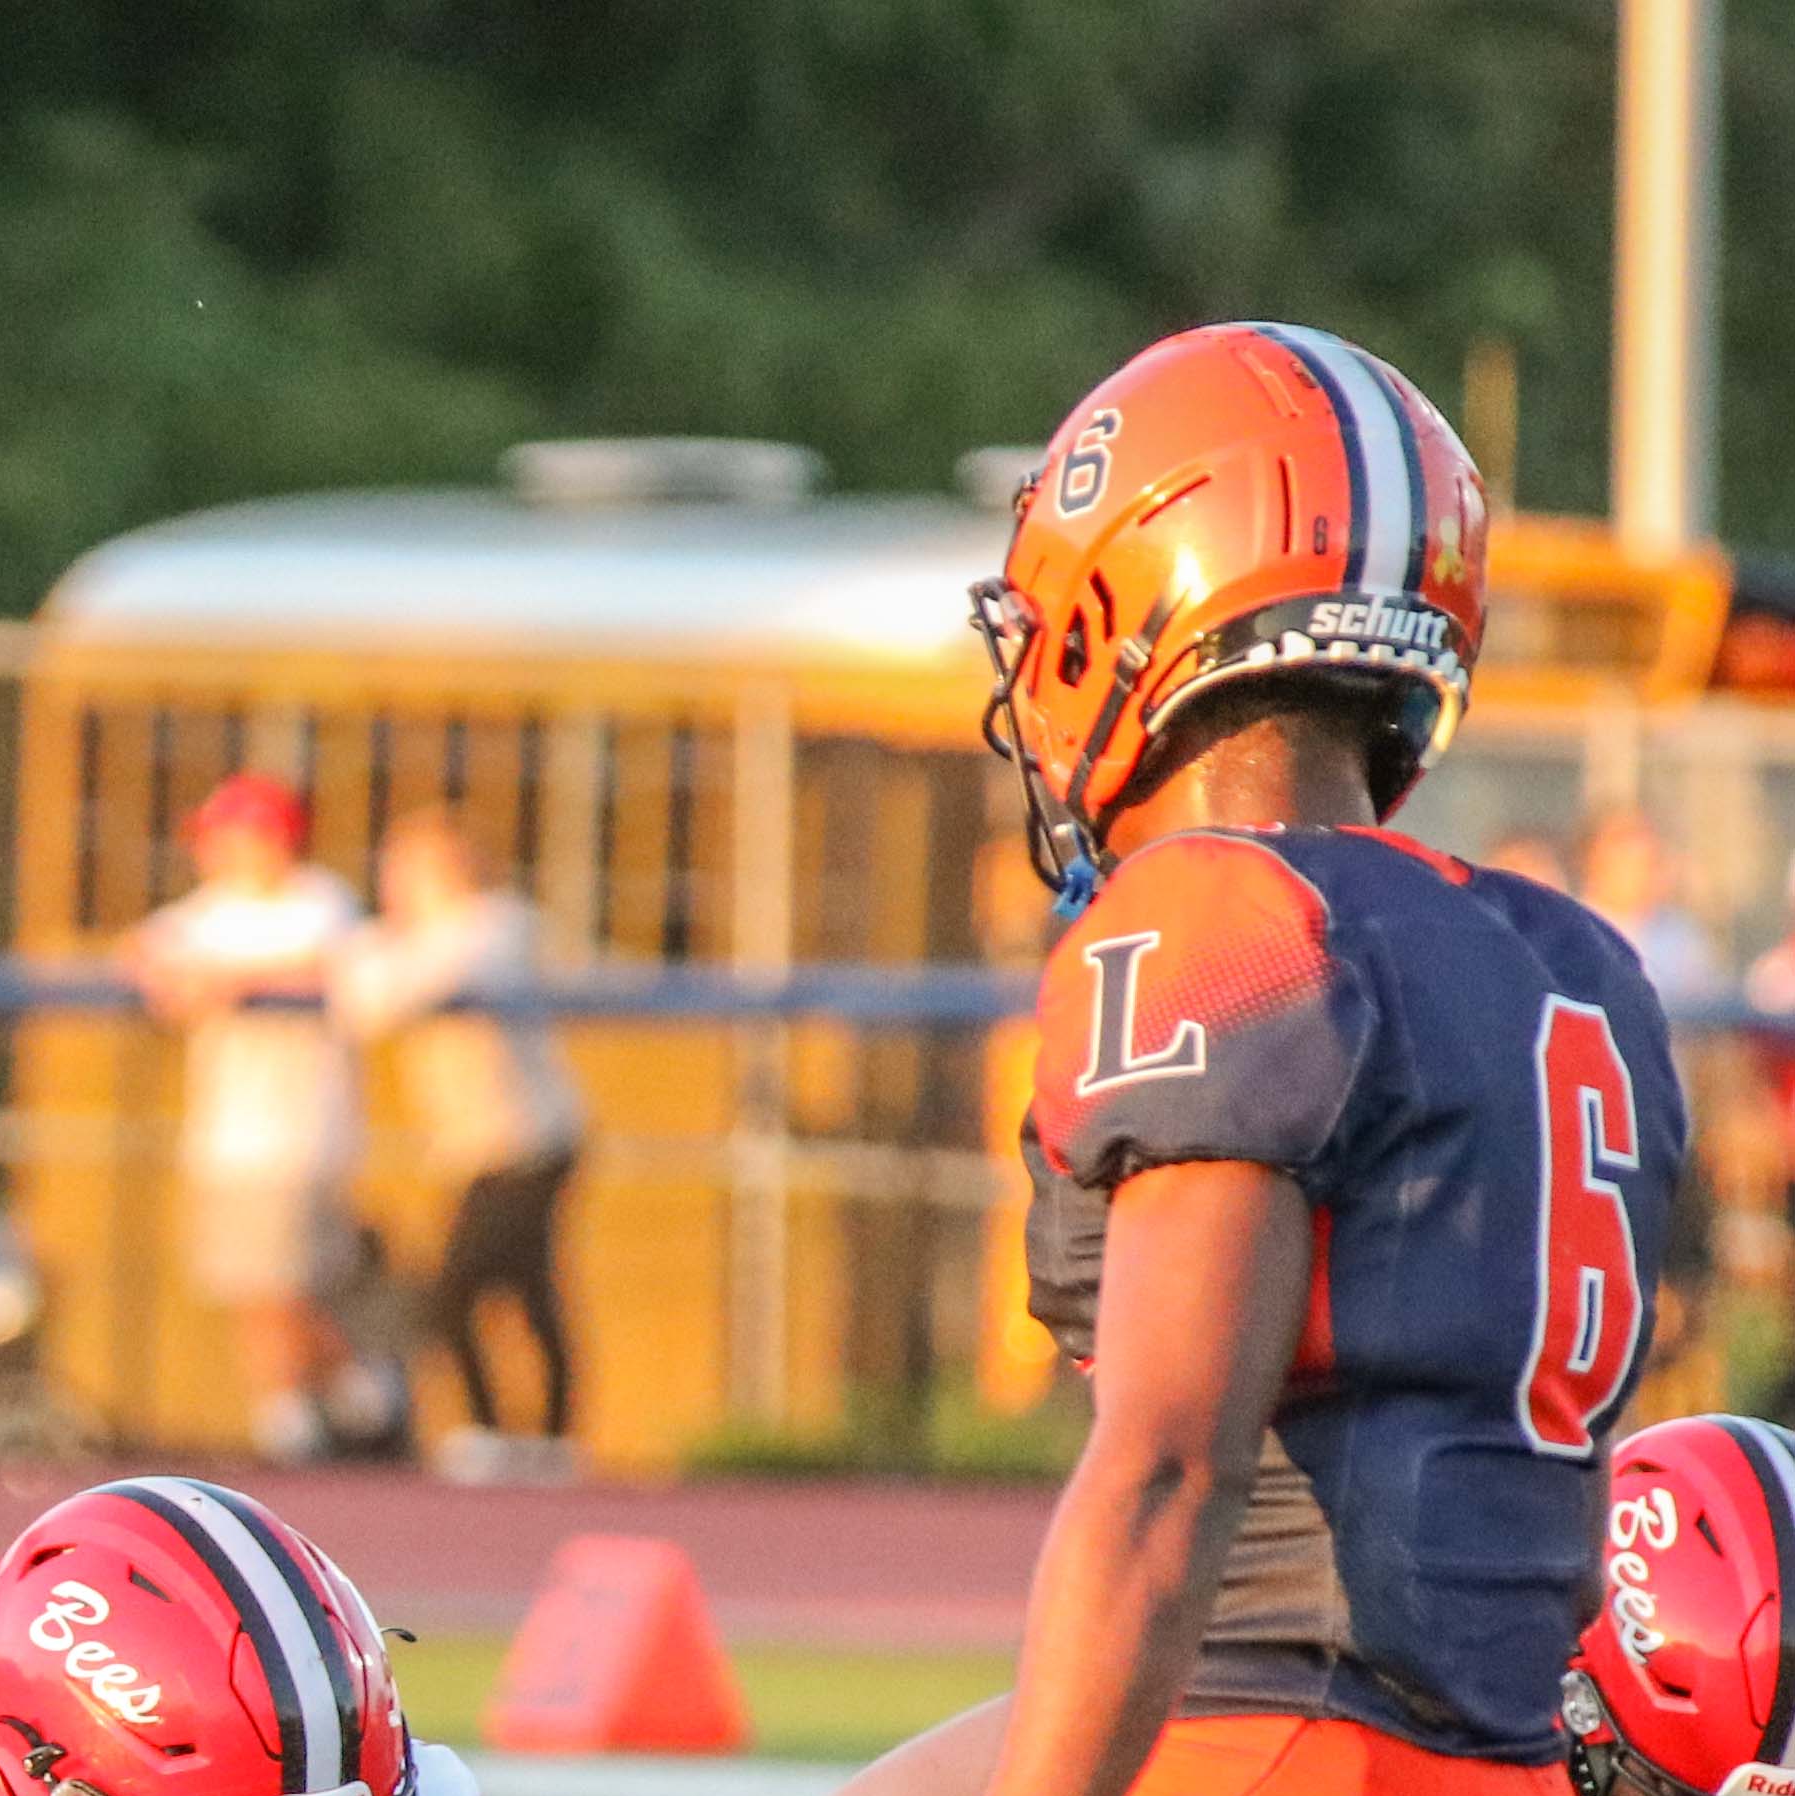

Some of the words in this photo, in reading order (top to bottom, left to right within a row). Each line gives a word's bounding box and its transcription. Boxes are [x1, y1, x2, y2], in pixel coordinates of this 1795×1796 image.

[1055, 407, 1124, 520] 6
[1313, 515, 1328, 556] 6
[1076, 930, 1207, 1099] L
[1515, 993, 1643, 1458] 6
[29, 1580, 164, 1724] Bees
[1609, 1487, 1679, 1666] Bees
